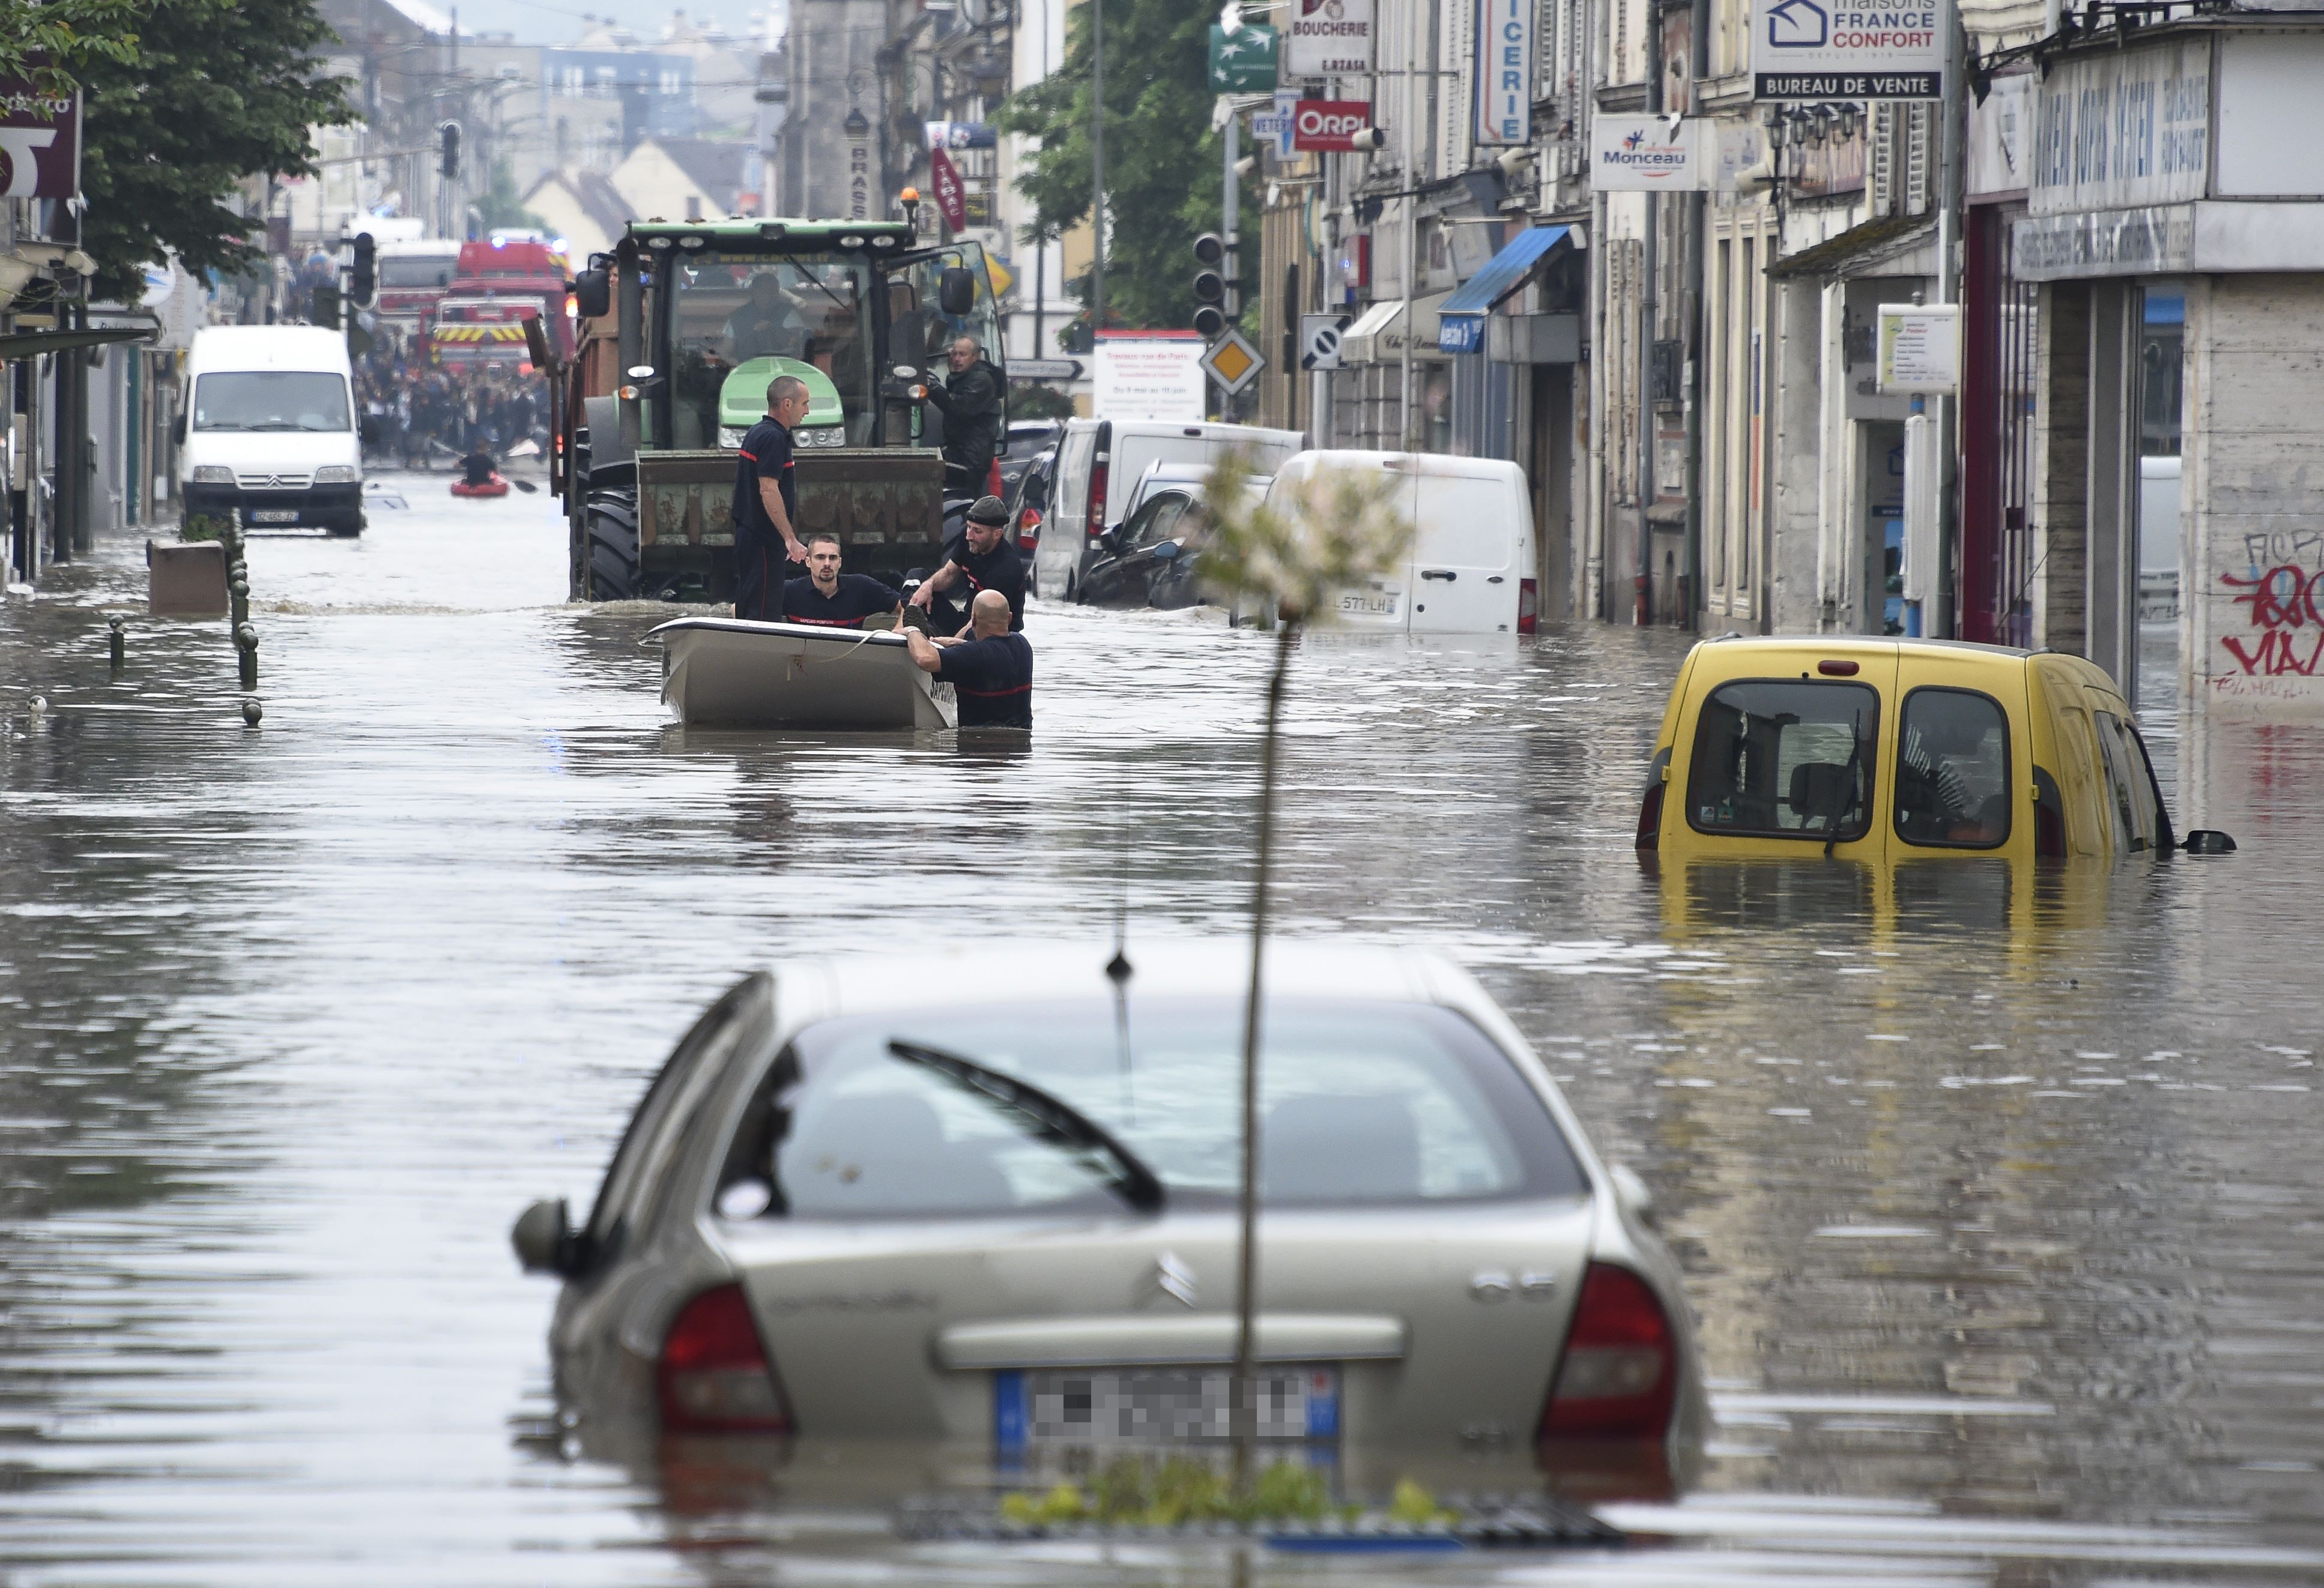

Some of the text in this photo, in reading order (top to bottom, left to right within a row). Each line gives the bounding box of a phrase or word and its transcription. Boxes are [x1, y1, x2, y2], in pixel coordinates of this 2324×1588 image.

[1833, 0, 1935, 9] maisons
[1834, 13, 1934, 28] FRANCE
[1294, 22, 1367, 36] BOUCHERIE
[1833, 32, 1934, 47] CONFORT
[1767, 77, 1929, 94] BUREAU DE VENTE
[1604, 151, 1686, 164] Monceau
[937, 164, 961, 216] TABAC
